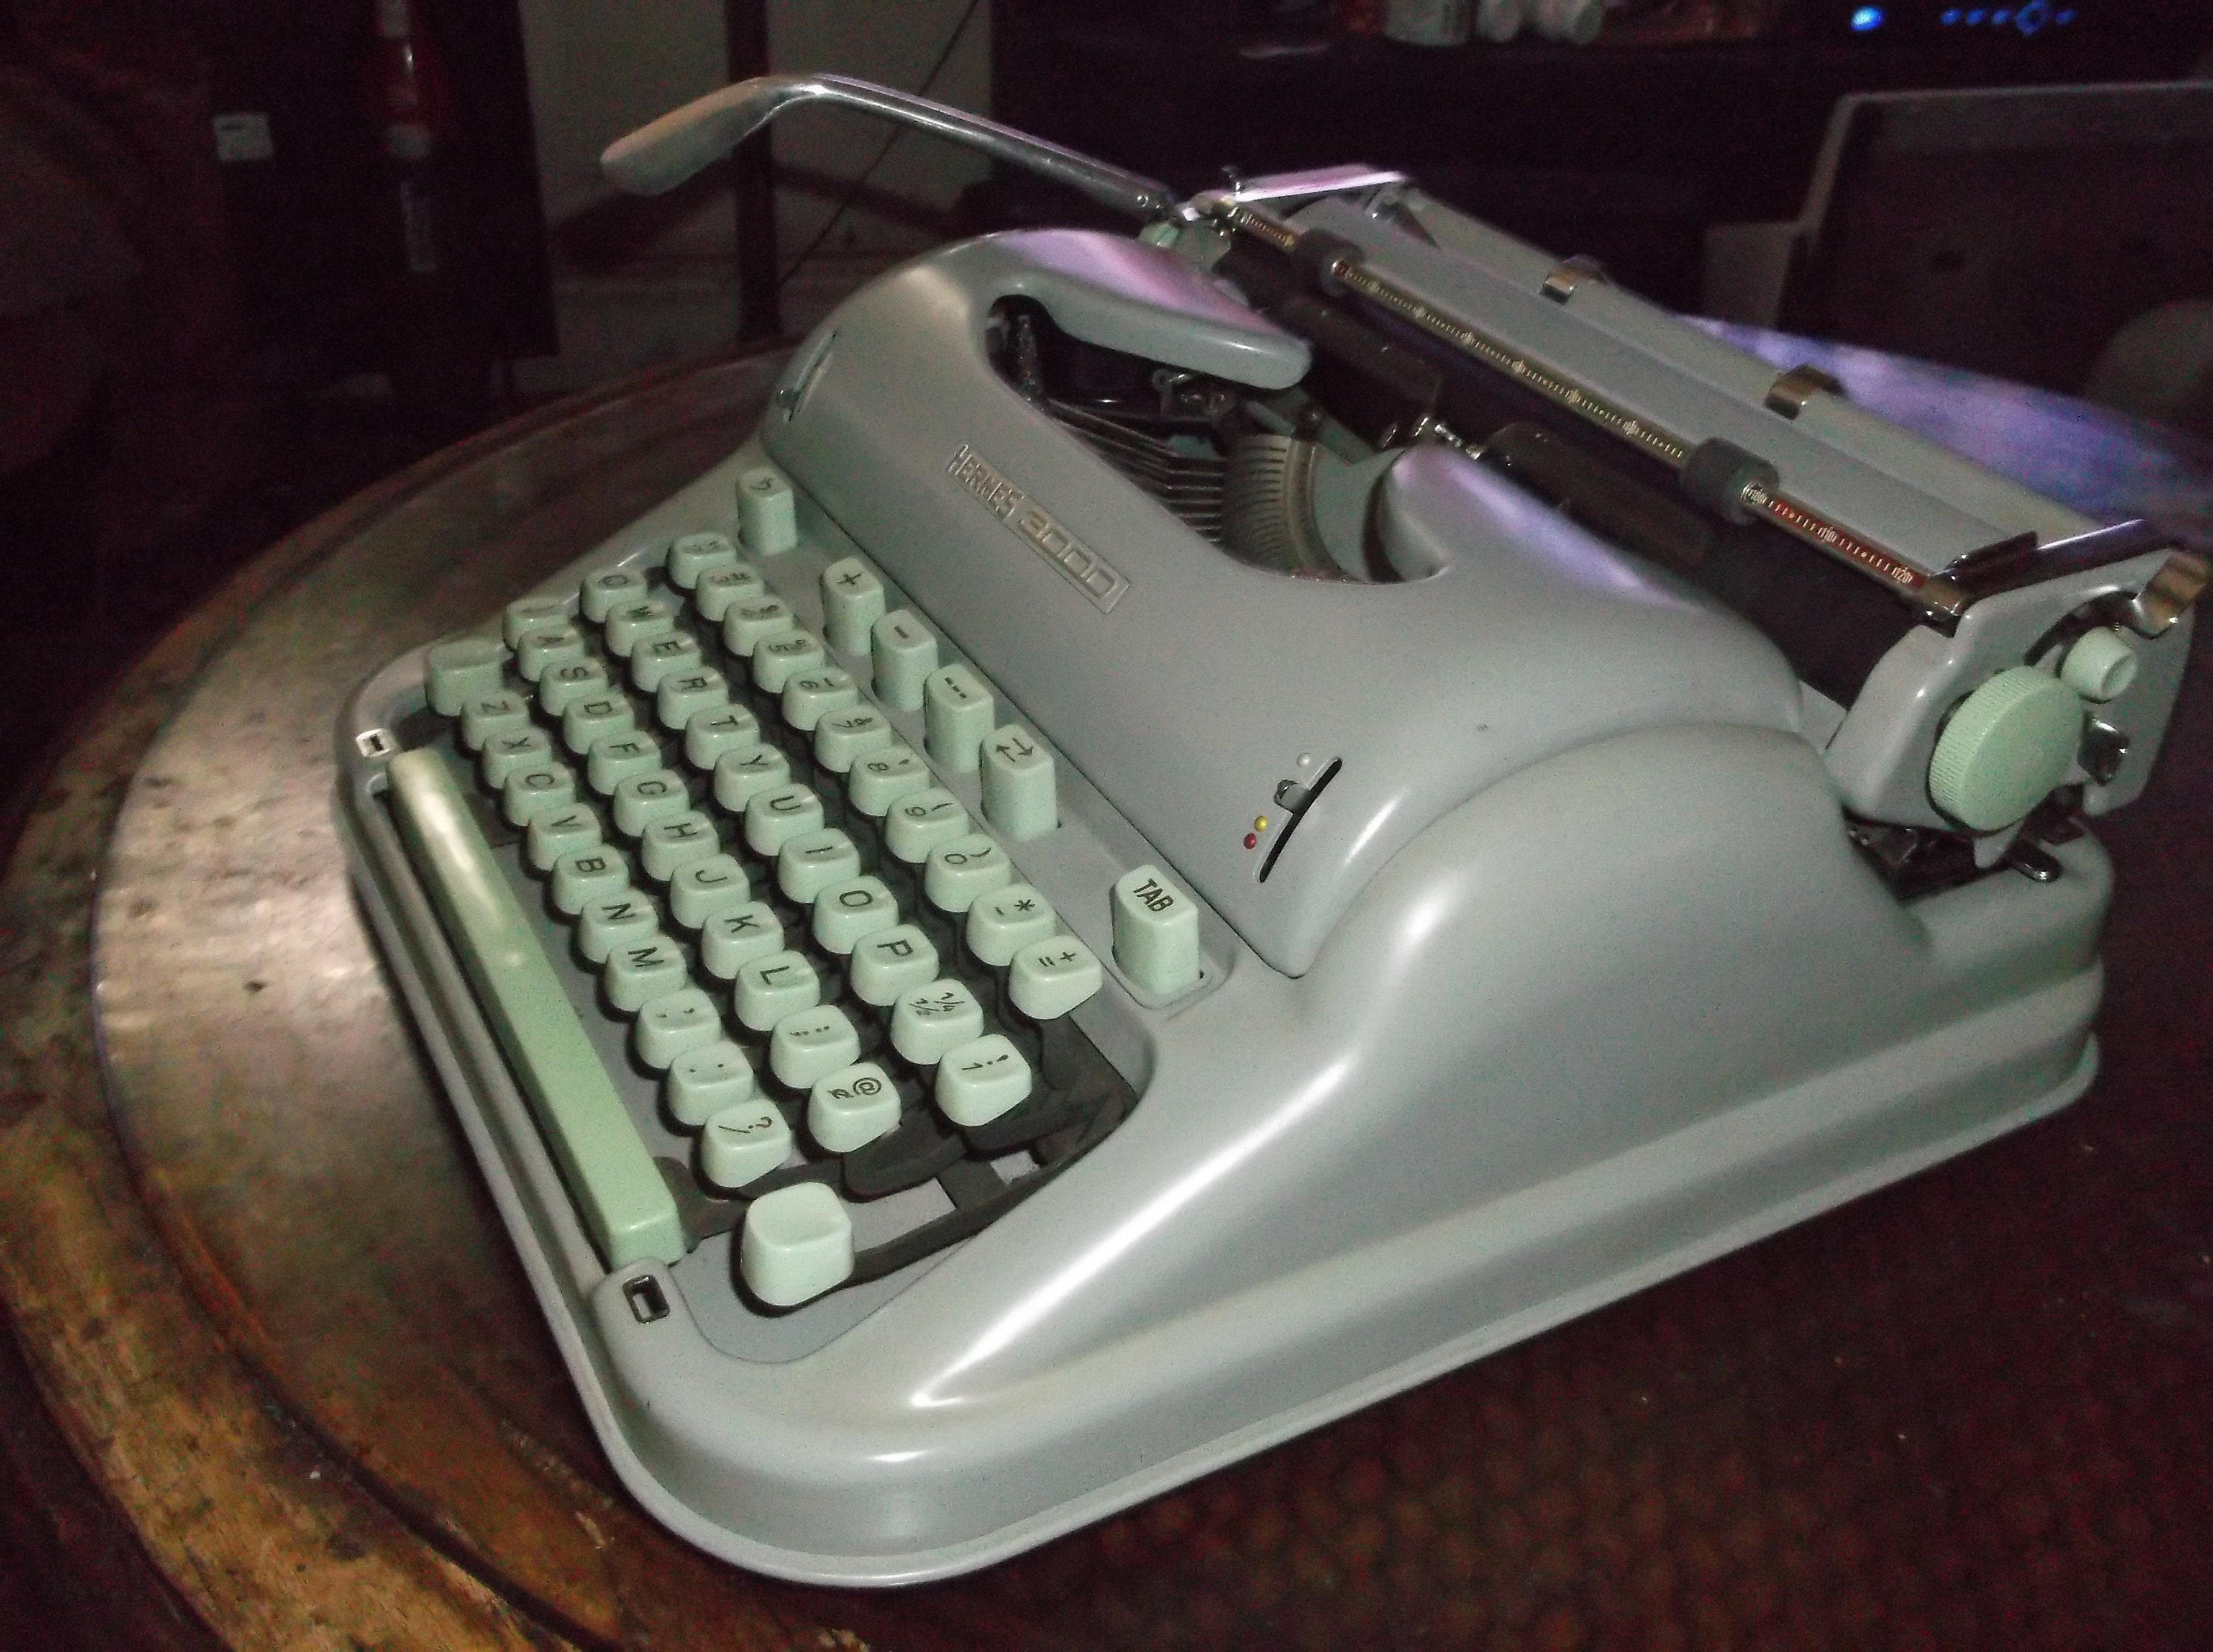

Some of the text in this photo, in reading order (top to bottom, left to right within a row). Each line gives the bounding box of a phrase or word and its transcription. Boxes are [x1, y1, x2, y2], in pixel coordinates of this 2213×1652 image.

[945, 443, 1117, 598] HERMES 3000
[652, 641, 682, 653] E
[560, 667, 588, 678] S
[678, 676, 708, 693] R
[481, 701, 510, 712] Z
[583, 701, 613, 715] D
[710, 715, 739, 726] T
[501, 736, 531, 749] X
[609, 742, 640, 754] F
[740, 754, 769, 766] Y
[867, 762, 890, 772] 8
[524, 774, 555, 787] C
[637, 780, 668, 795] G
[769, 794, 801, 811] U
[904, 806, 927, 816] 9
[550, 814, 584, 828] V
[663, 822, 699, 839] H
[574, 856, 607, 873] B
[695, 869, 728, 884] J
[839, 890, 873, 907] O
[1133, 878, 1174, 912] TAB
[601, 902, 637, 920] N
[723, 914, 761, 933] K
[876, 939, 913, 957] P
[627, 945, 665, 968] M
[759, 965, 791, 985] L
[852, 1076, 883, 1096] @
[748, 1115, 774, 1129] ?
